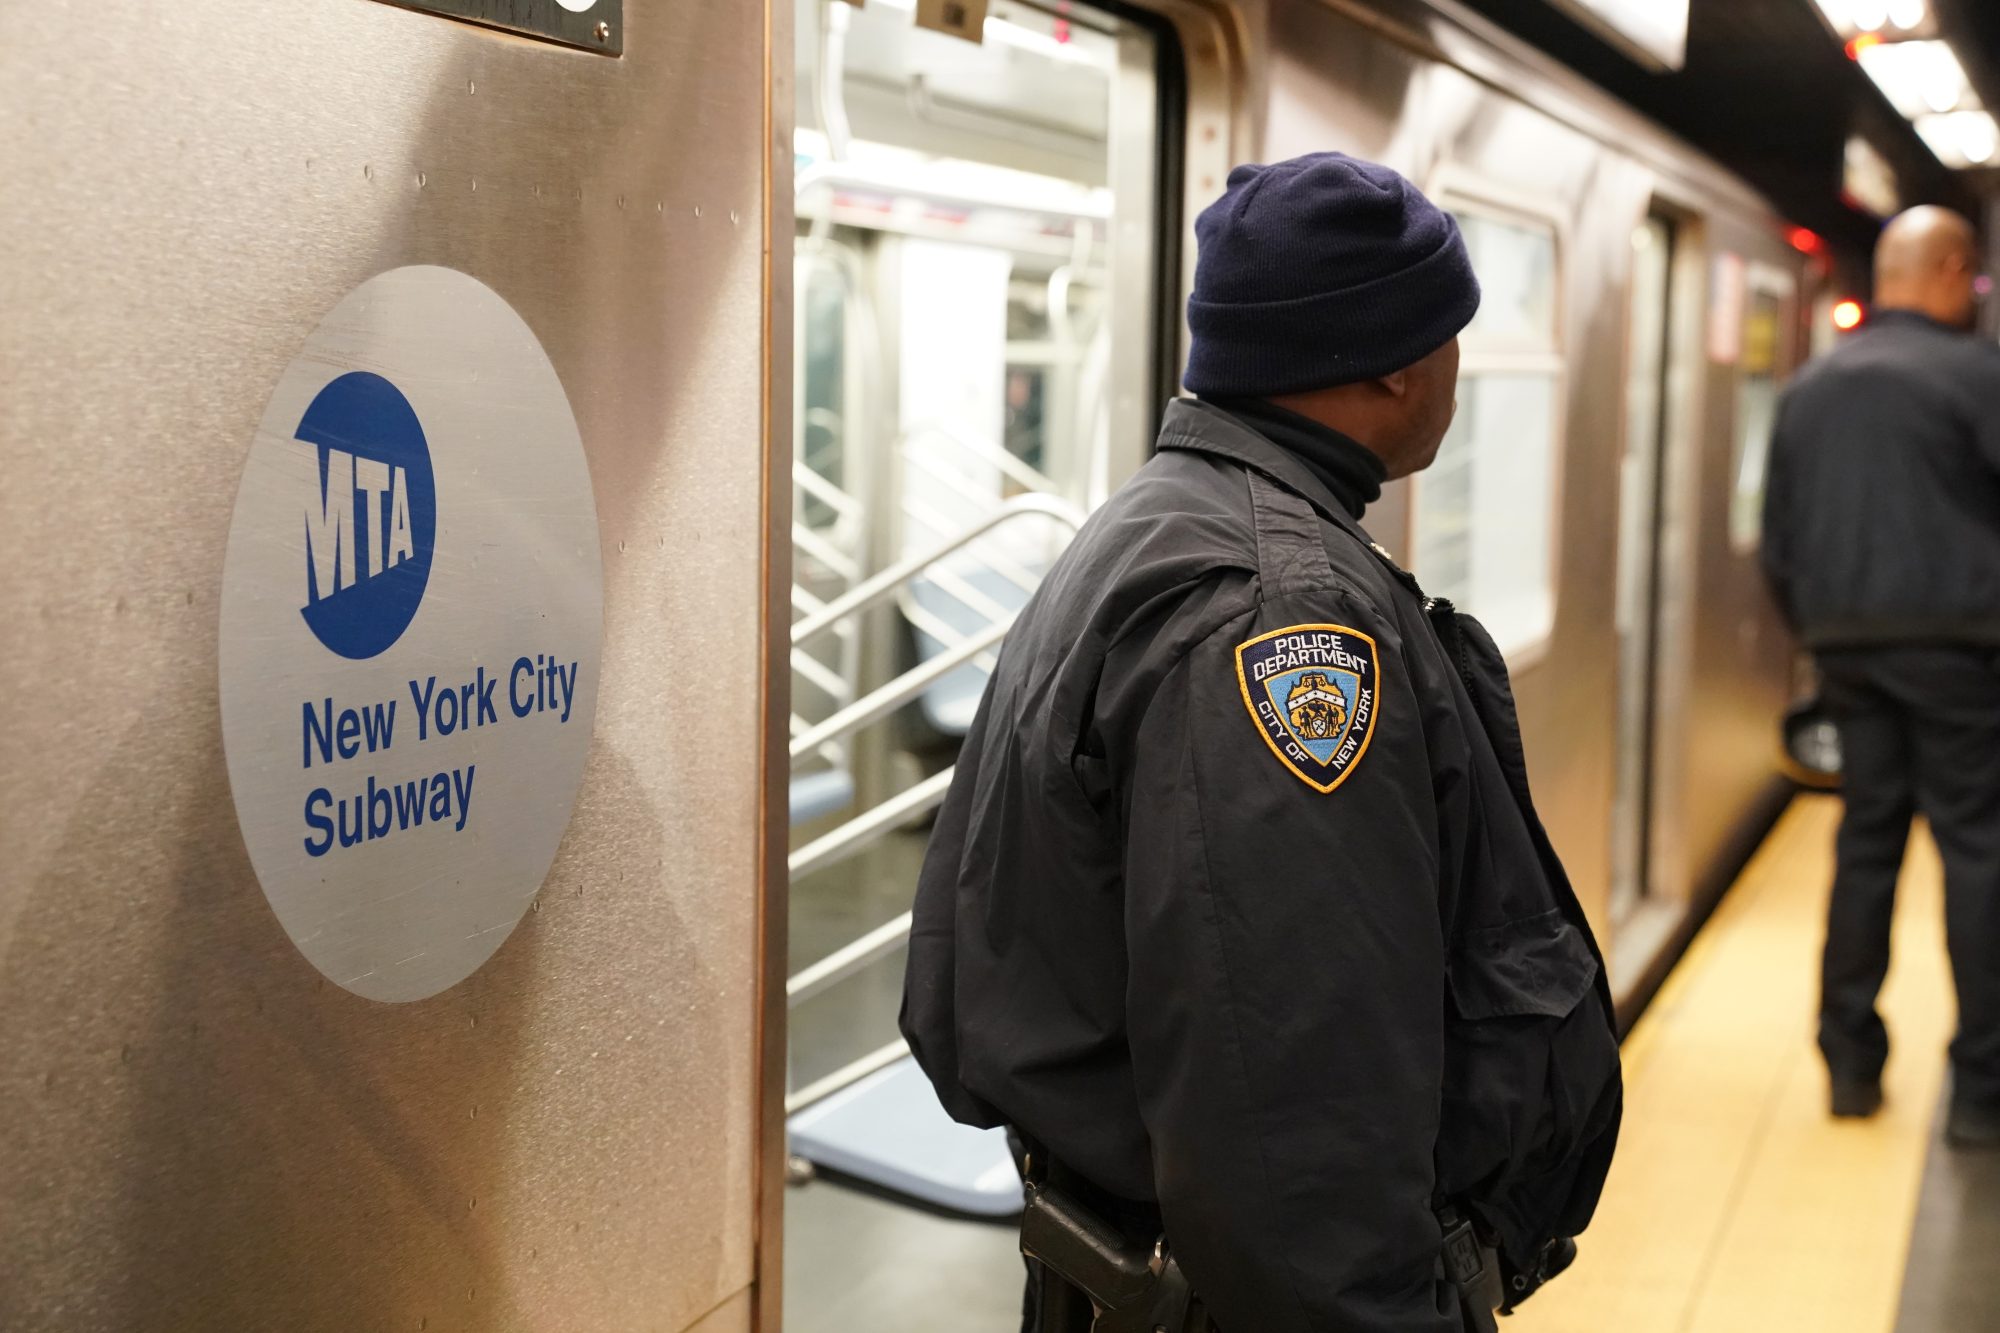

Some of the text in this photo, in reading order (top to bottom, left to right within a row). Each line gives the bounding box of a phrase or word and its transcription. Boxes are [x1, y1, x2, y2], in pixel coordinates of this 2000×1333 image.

[295, 438, 414, 606] MTA
[1253, 648, 1368, 682] DEPARTMENT
[1274, 633, 1343, 654] POLICE
[302, 653, 579, 769] New York City
[1258, 687, 1372, 770] CITY OF NEW YORK
[302, 764, 476, 858] Subway
